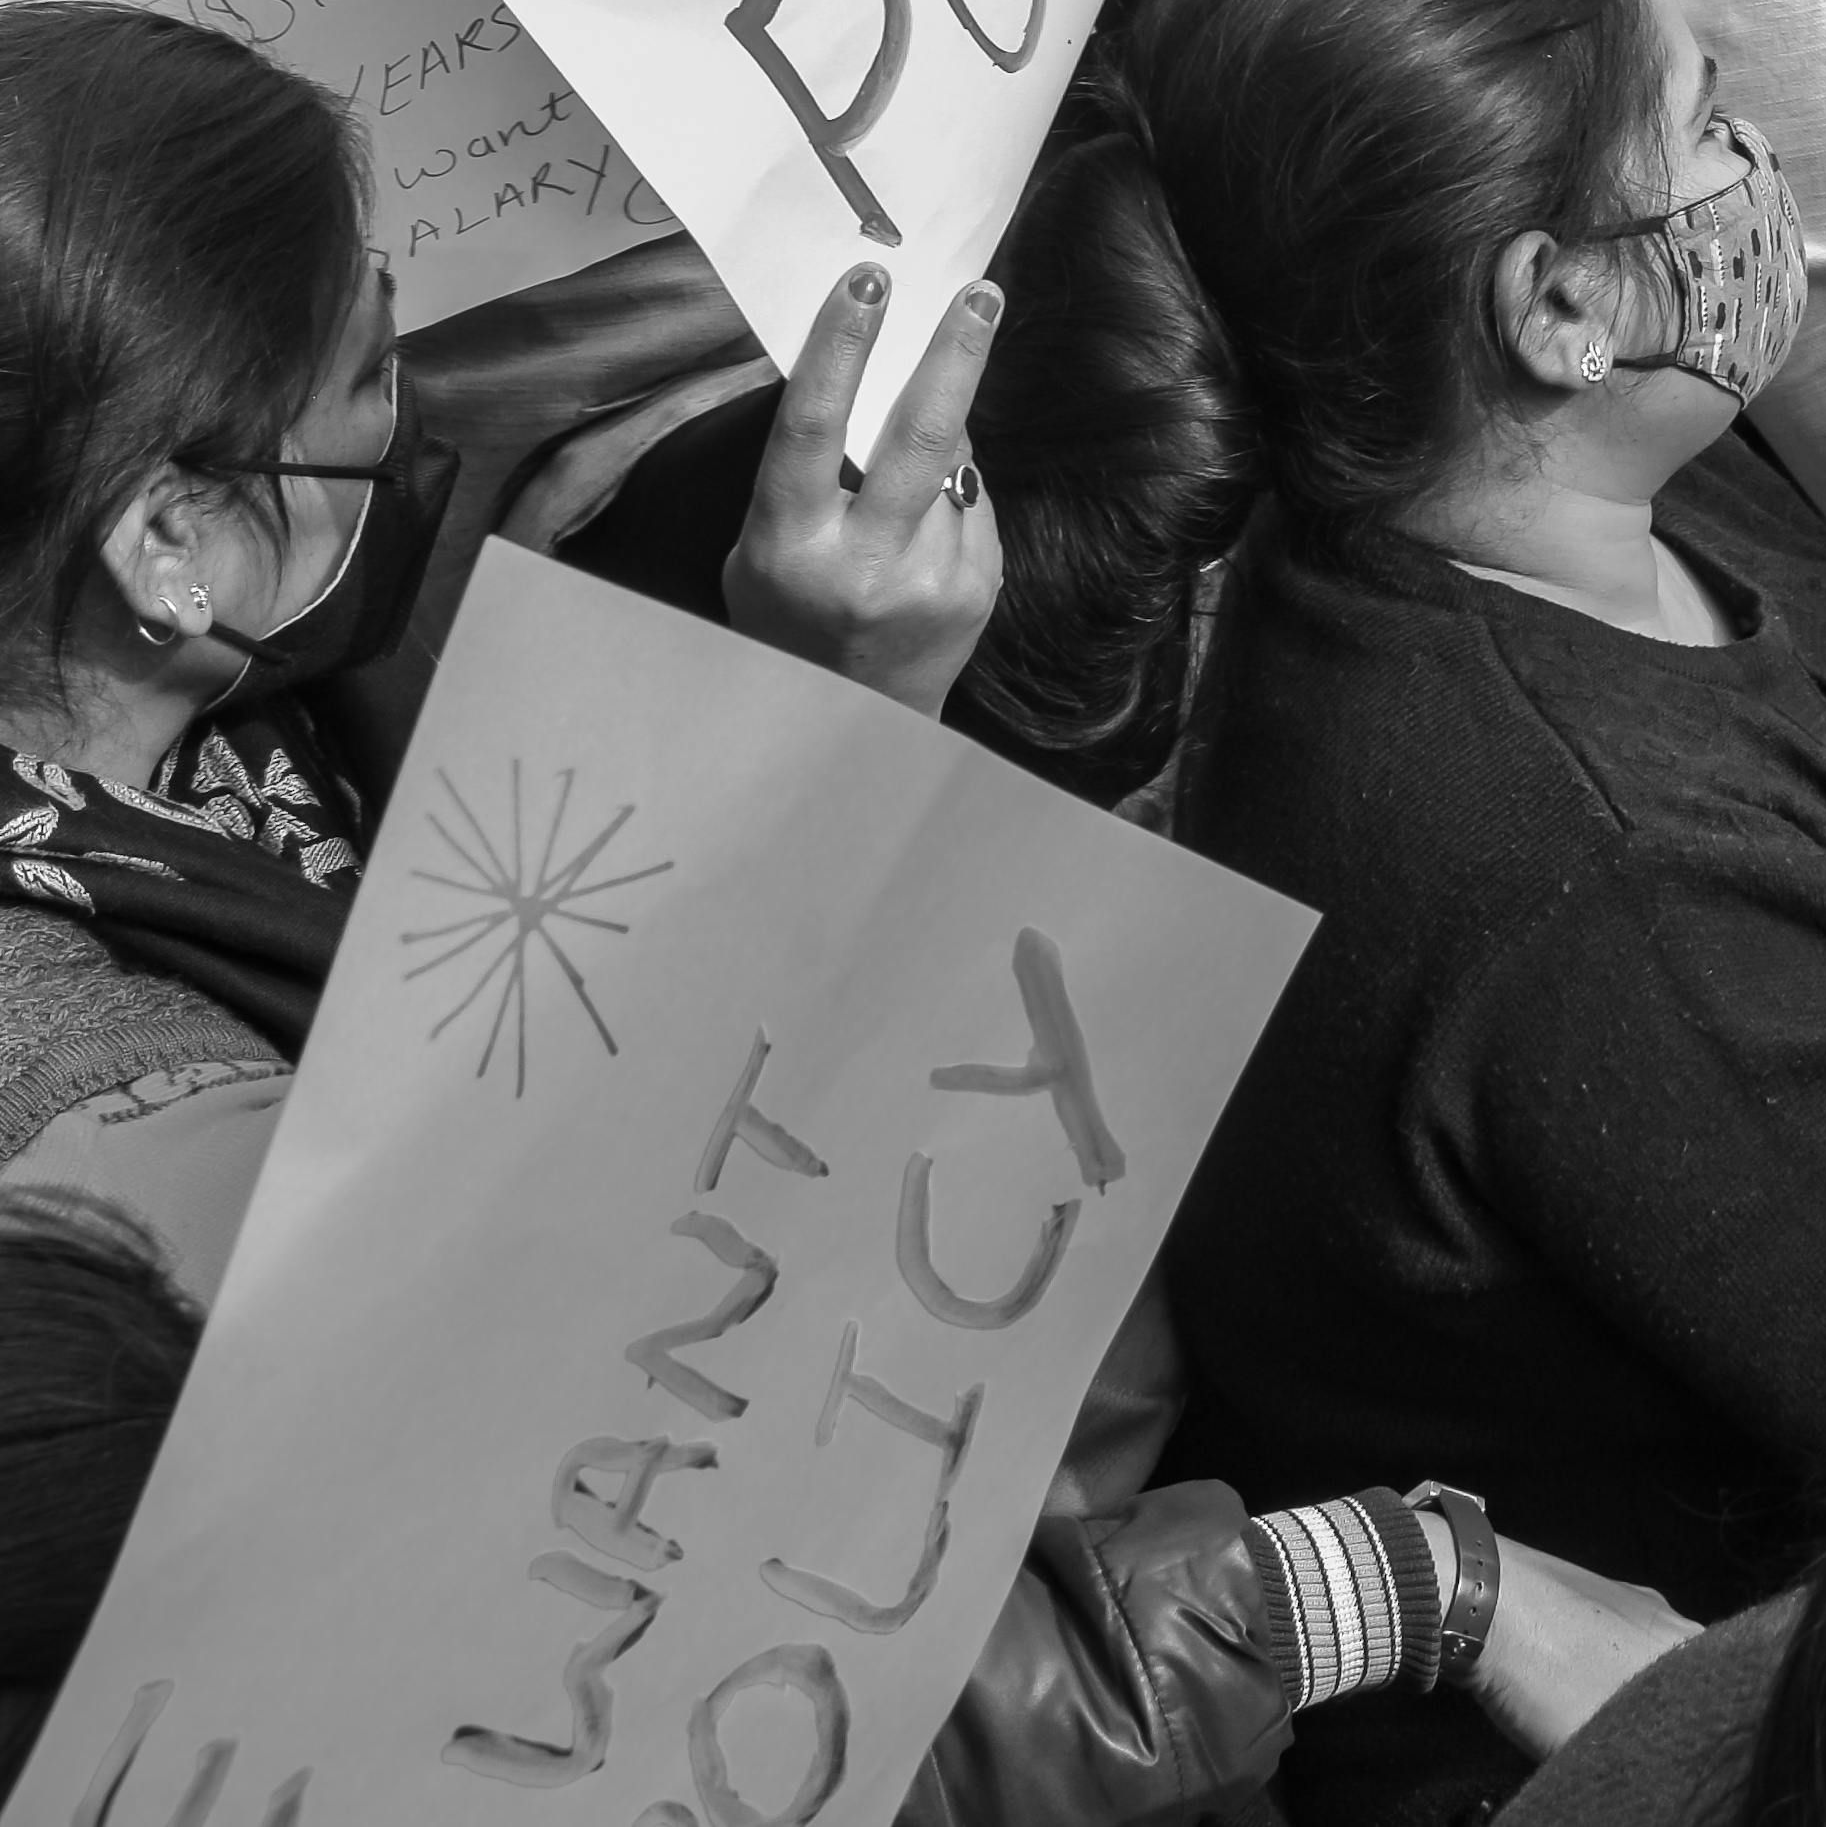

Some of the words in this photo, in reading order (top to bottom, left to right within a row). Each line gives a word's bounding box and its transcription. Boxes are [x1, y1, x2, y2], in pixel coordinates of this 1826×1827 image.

[366, 144, 610, 272] ALARY
[394, 90, 573, 190] want
[440, 1024, 831, 1791] WANT
[628, 926, 1127, 1827] OLICY
